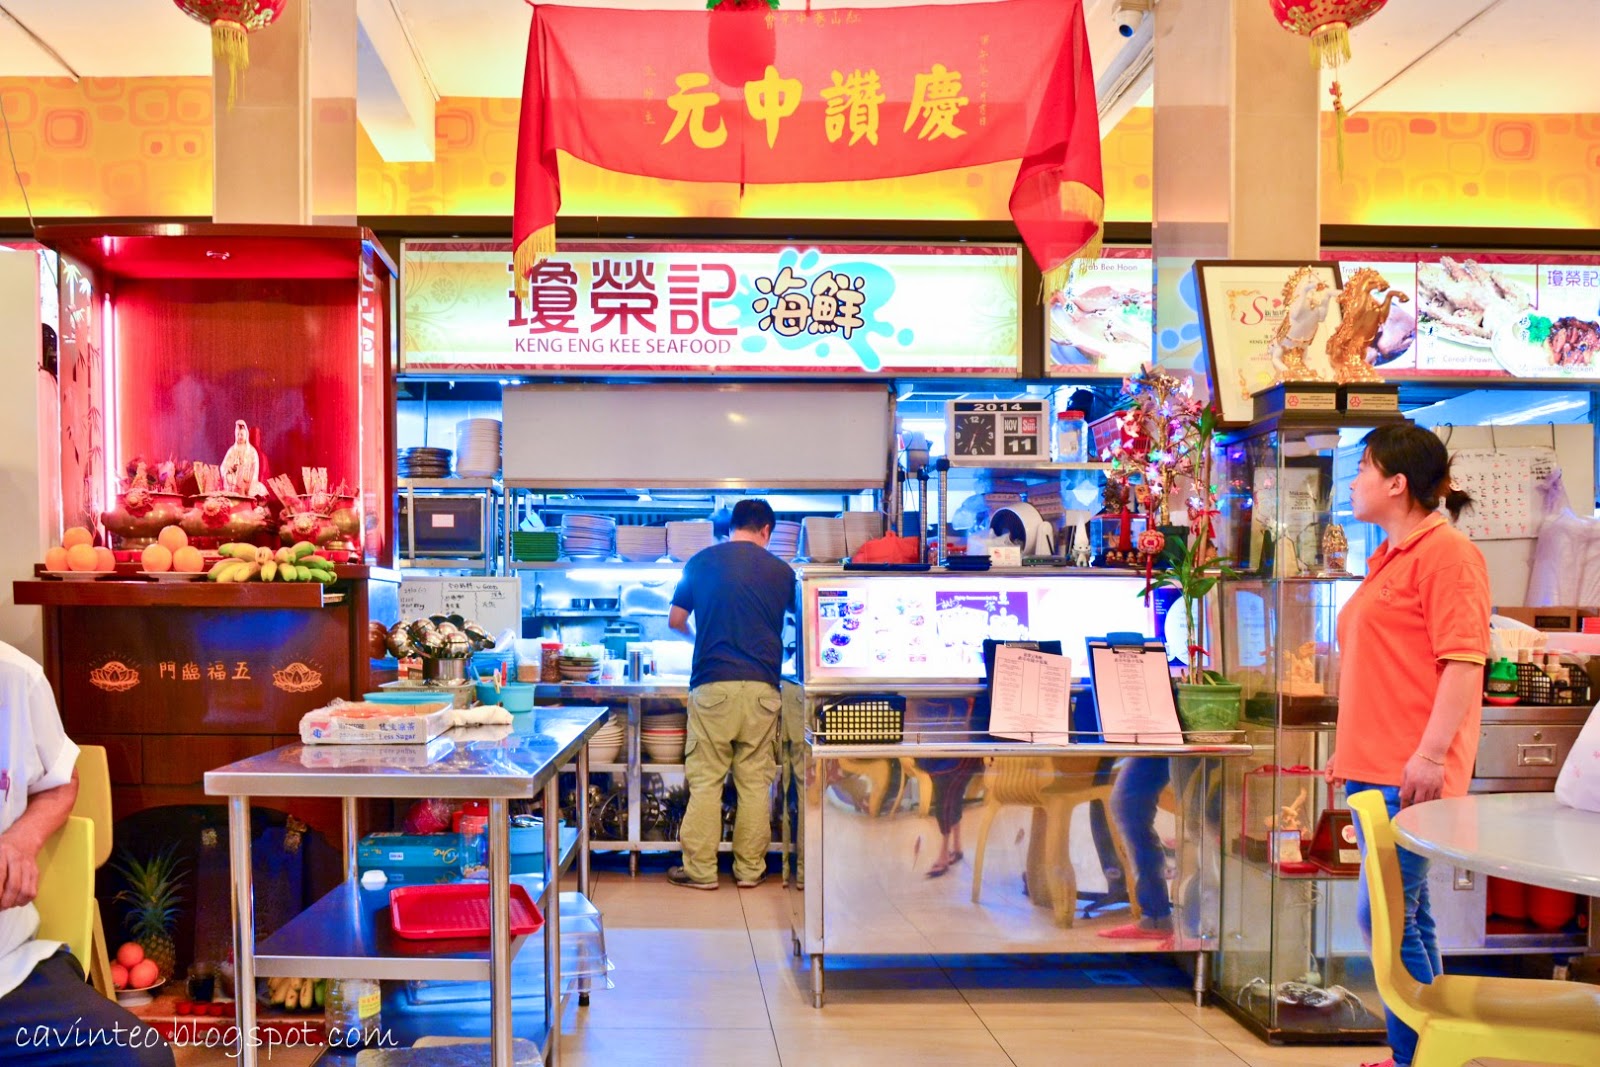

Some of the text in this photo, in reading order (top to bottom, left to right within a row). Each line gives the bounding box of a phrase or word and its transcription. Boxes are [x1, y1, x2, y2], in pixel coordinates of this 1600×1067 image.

[1101, 263, 1115, 271] Bee
[1117, 263, 1138, 271] Hoon
[752, 266, 866, 340] 海鮮
[515, 338, 731, 354] KENG ENG KEE SEAFOOD
[973, 403, 1022, 411] 2014
[1004, 419, 1036, 431] NOV Sun
[1008, 438, 1031, 453] 11
[395, 732, 416, 742] Sugar
